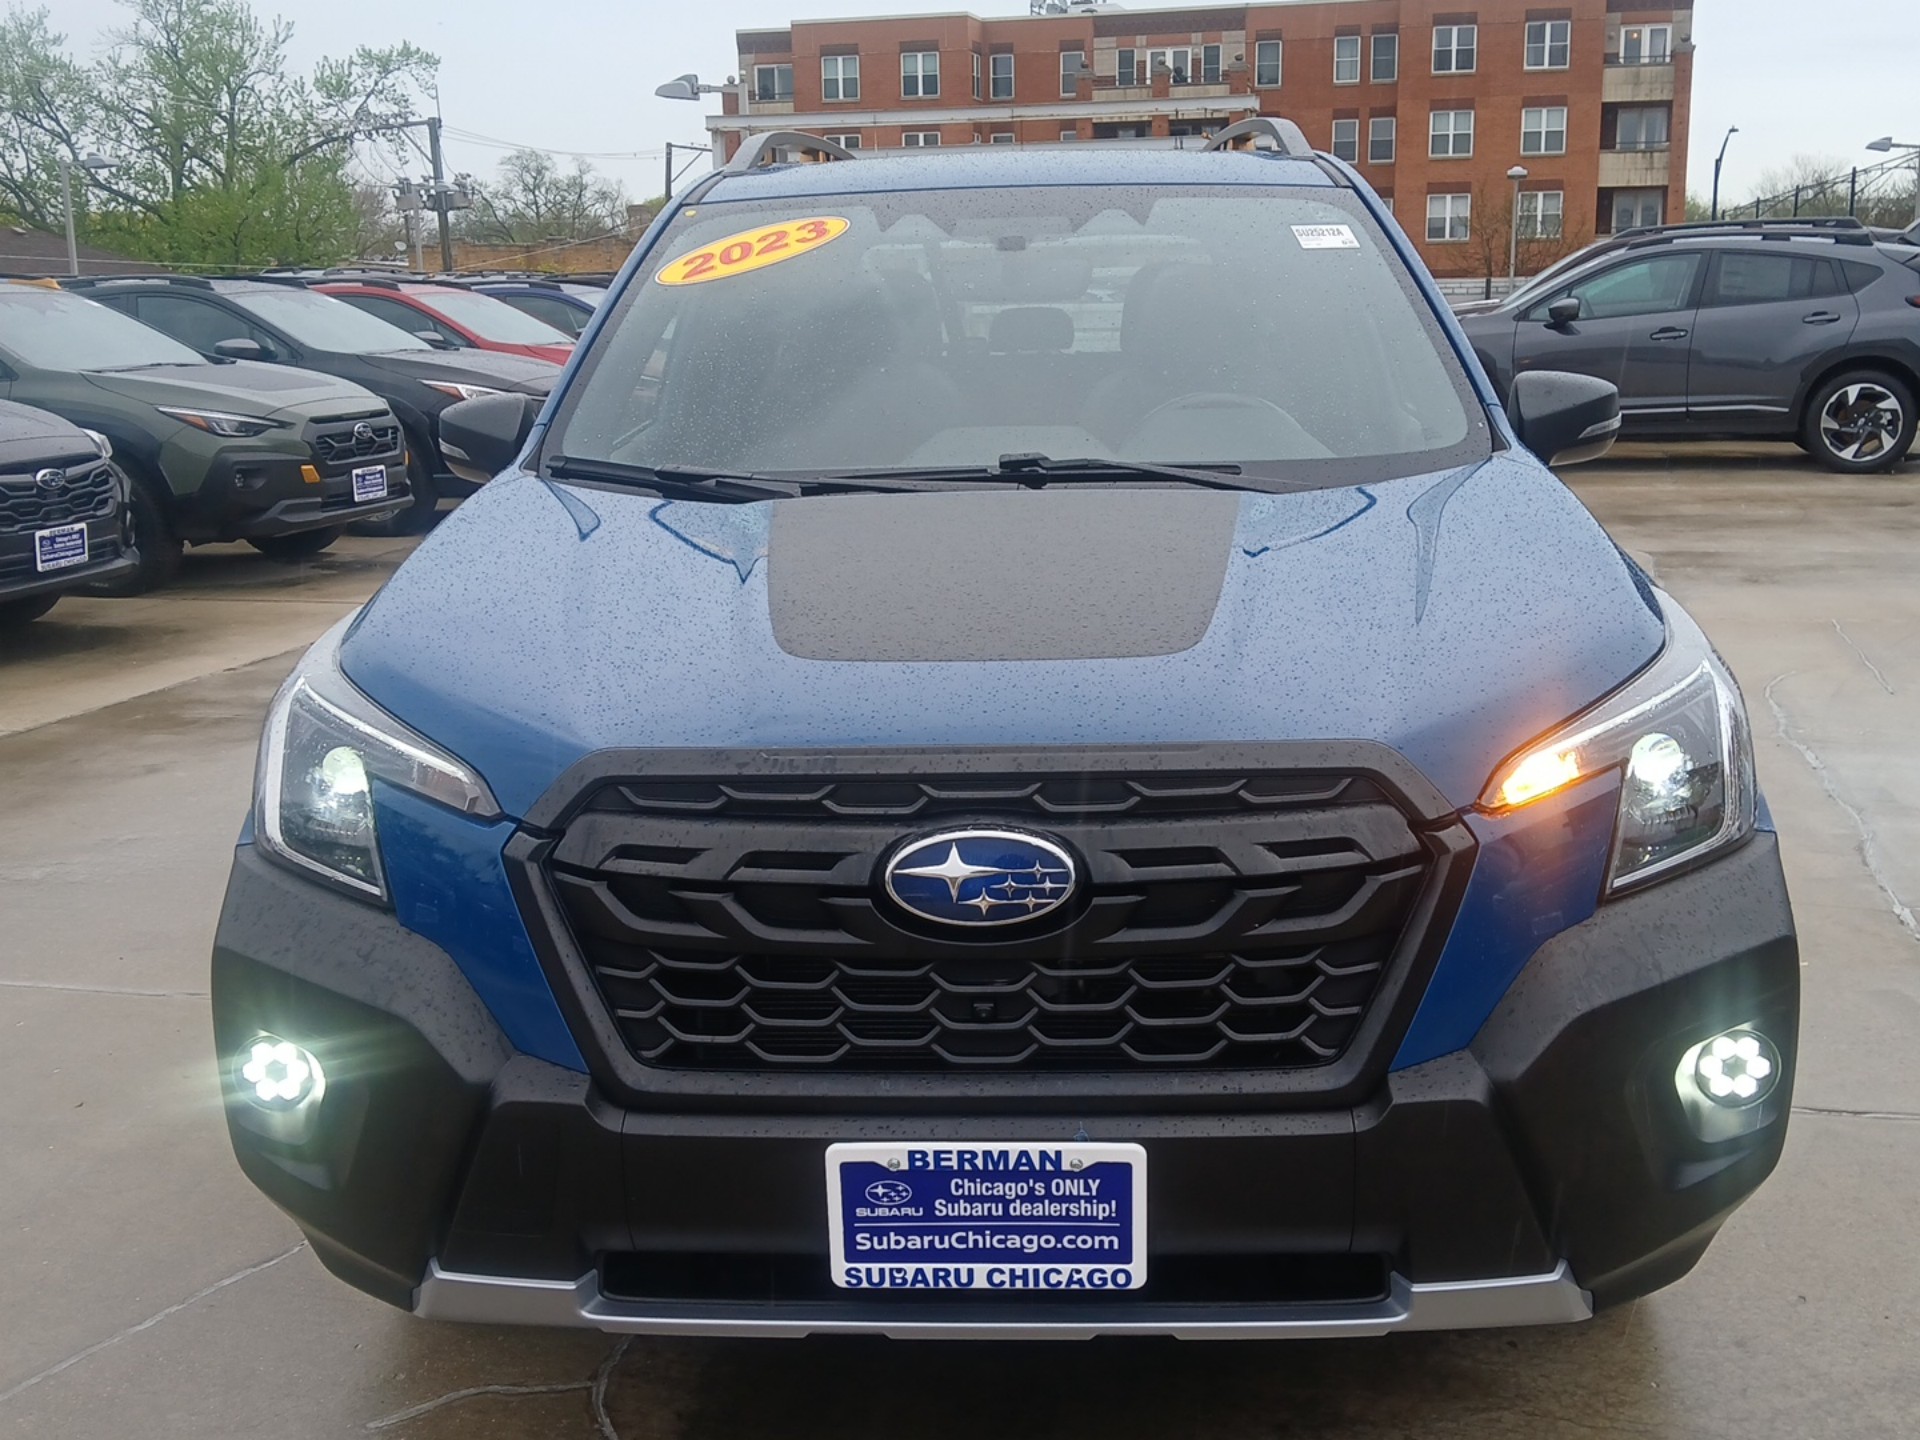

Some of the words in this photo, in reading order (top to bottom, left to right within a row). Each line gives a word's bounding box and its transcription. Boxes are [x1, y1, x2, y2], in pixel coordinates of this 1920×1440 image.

[681, 220, 829, 280] 2023
[907, 1149, 1063, 1171] BERMAN
[950, 1178, 1046, 1199] Chicago's
[1051, 1179, 1101, 1196] ONLY
[855, 1207, 924, 1217] SUBARU
[934, 1199, 1006, 1217] Subaru
[1009, 1199, 1117, 1220] dealership!
[855, 1231, 1120, 1253] SubaruChicago.com
[844, 1268, 975, 1288] SUBARU
[986, 1267, 1133, 1289] CHICAGO
